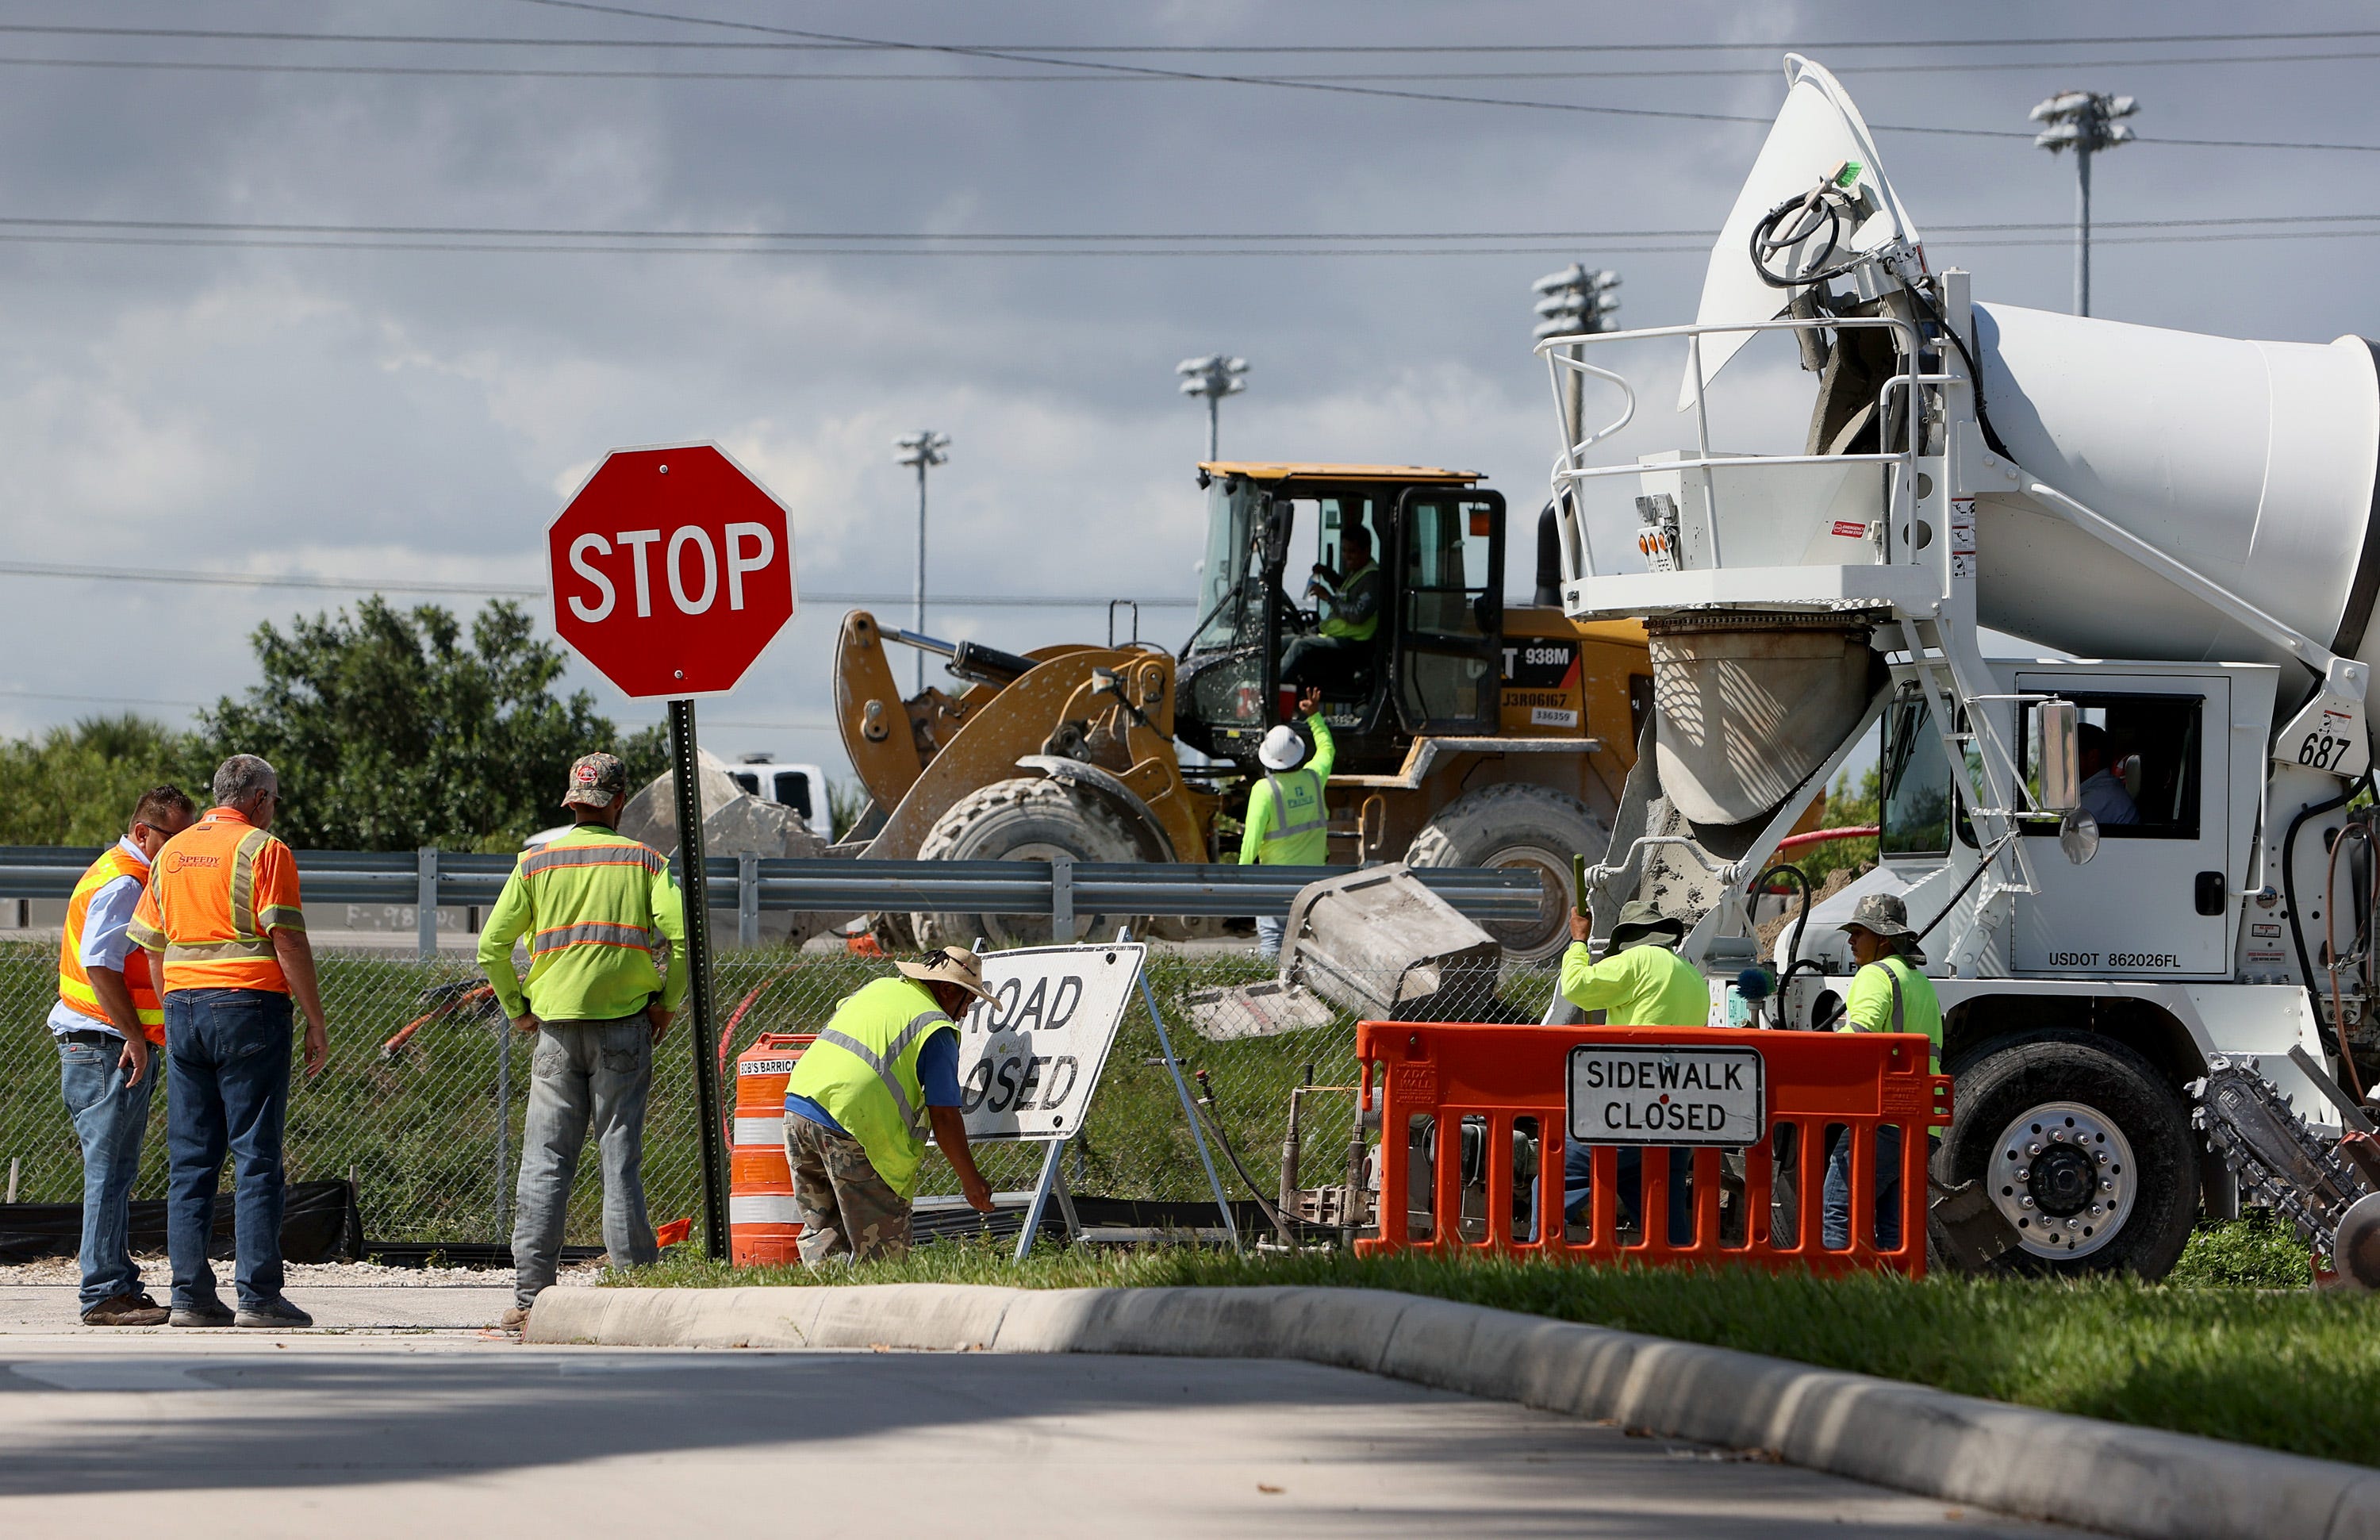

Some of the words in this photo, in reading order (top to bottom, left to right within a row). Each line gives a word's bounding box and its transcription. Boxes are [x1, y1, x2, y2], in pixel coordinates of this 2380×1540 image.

[567, 522, 774, 623] STOP
[1526, 647, 1568, 665] 938M
[2298, 732, 2351, 771] 687
[178, 856, 221, 865] SPEEDY
[2049, 953, 2100, 966] USDOT
[2108, 953, 2181, 968] 862026FL
[741, 1062, 759, 1074] BOB'S
[760, 1060, 798, 1073] BARRICA
[1587, 1061, 1744, 1091] SIDEWALK
[961, 1055, 1079, 1115] OSED
[1604, 1101, 1726, 1131] CLOSED
